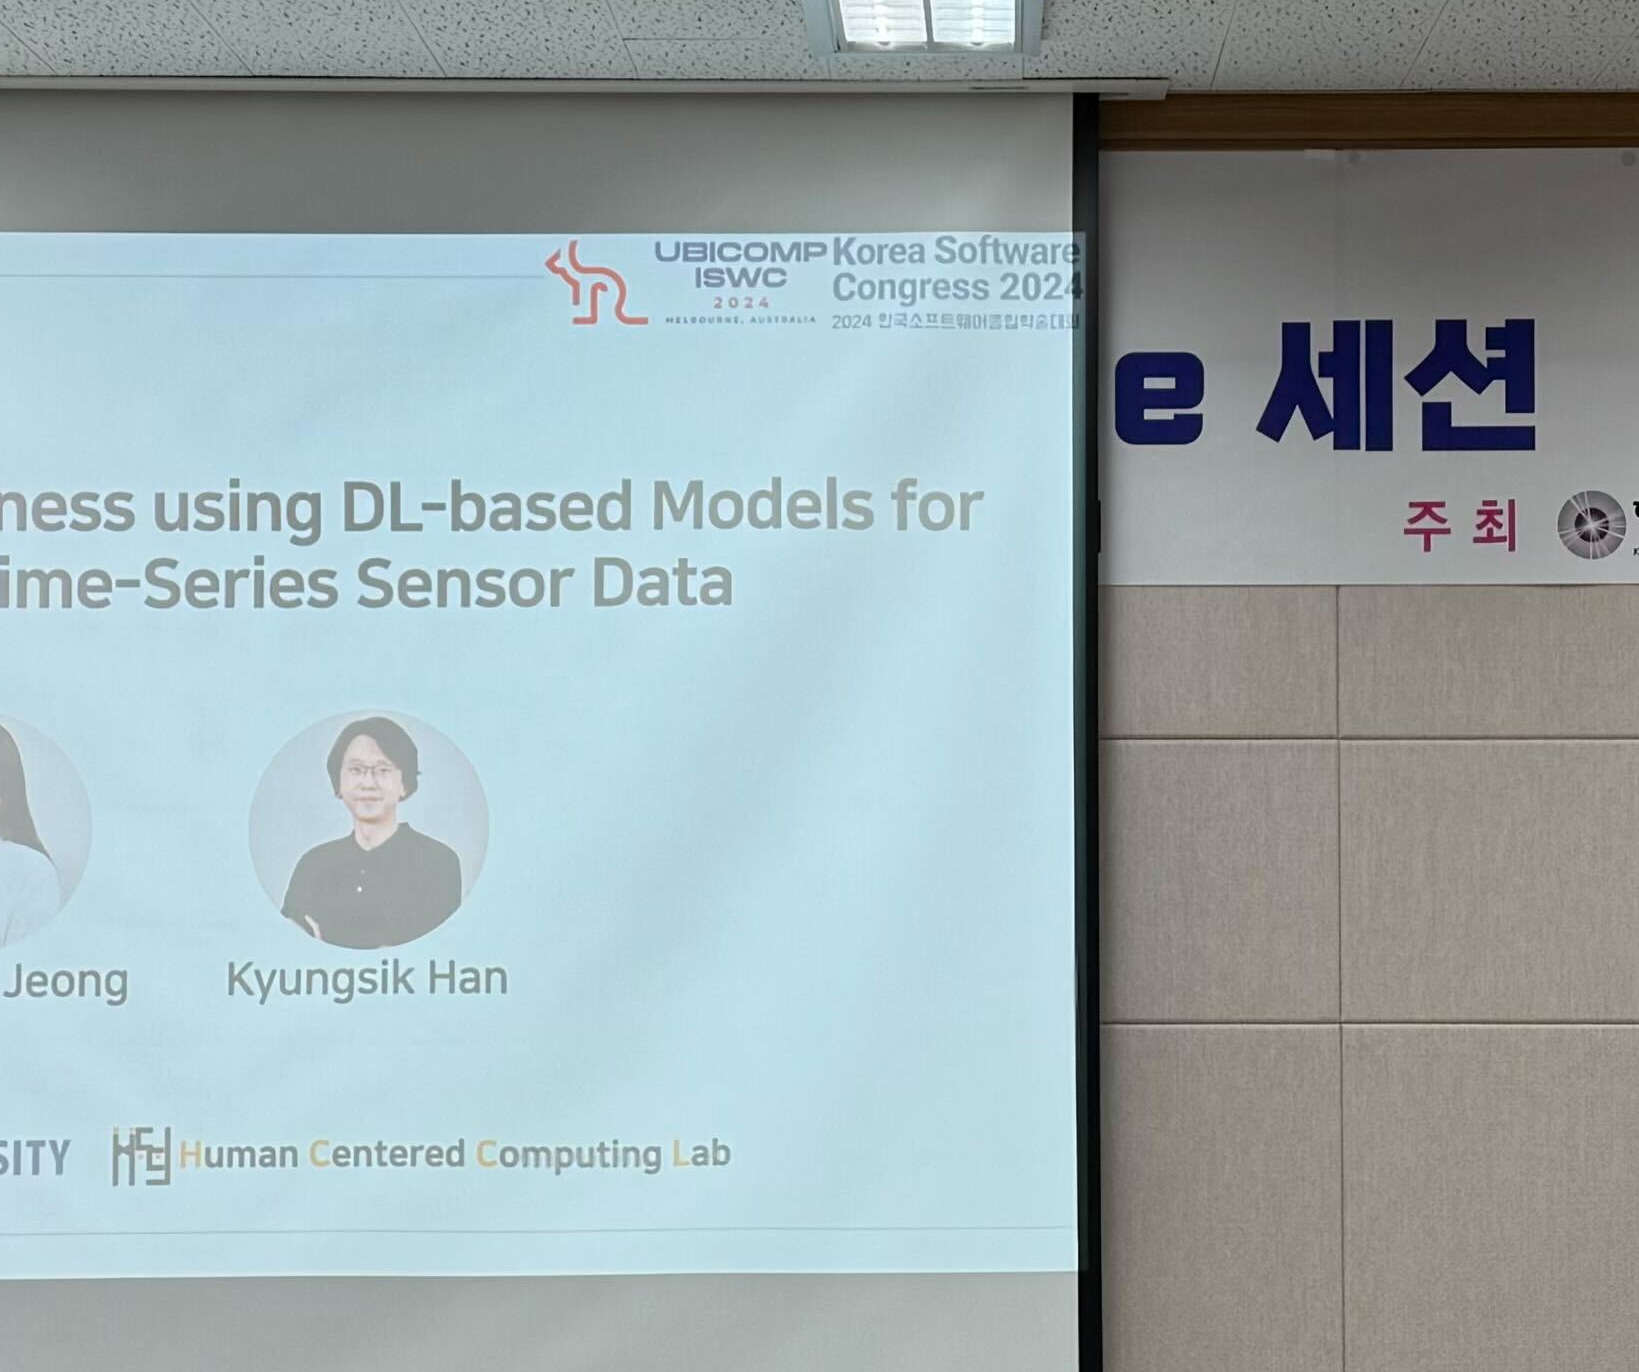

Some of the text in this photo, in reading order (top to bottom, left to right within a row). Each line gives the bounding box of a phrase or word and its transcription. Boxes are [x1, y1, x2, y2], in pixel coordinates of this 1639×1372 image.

[654, 241, 828, 263] UBICOMP
[833, 234, 1082, 266] Korea Software
[695, 267, 788, 288] ISWC
[832, 271, 1084, 307] Congress 2024
[713, 296, 770, 310] 2024
[831, 314, 873, 330] 2024
[1256, 318, 1536, 451] 세션
[154, 478, 322, 547] using
[344, 478, 632, 532] DL-based
[653, 476, 875, 531] Models
[891, 478, 985, 531] for
[357, 557, 575, 609] Sensor
[593, 556, 733, 607] Data
[3, 963, 128, 1004] Jeong
[227, 960, 509, 1004] Kyungsik Han
[179, 1139, 299, 1169] Human
[309, 1138, 465, 1169] Centered
[476, 1139, 662, 1175] Computing
[672, 1138, 732, 1168] Lab
